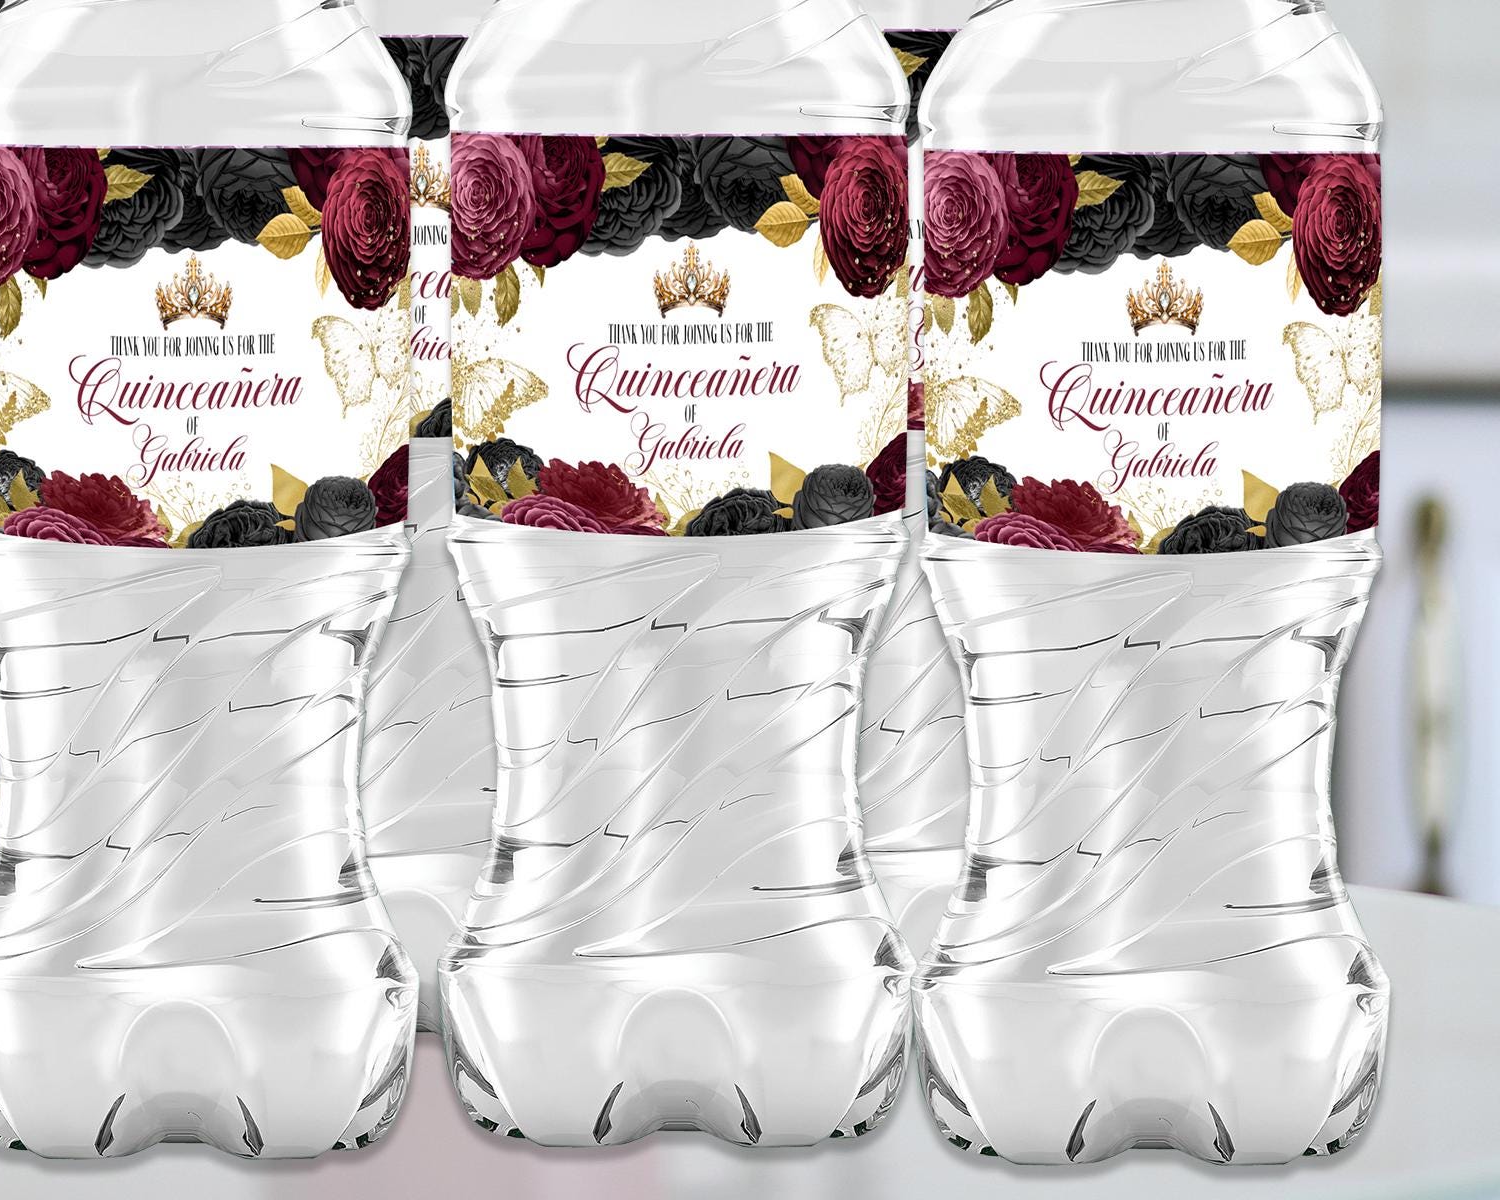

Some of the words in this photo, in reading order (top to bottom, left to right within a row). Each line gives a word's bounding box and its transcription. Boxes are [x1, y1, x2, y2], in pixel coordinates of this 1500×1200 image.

[413, 225, 447, 245] JOINING
[415, 305, 426, 324] OF
[609, 324, 637, 344] THANK
[641, 324, 658, 344] YOU
[662, 325, 679, 345] FOR
[683, 324, 717, 344] JOINING
[721, 324, 732, 344] US
[736, 323, 753, 343] FOR
[757, 322, 773, 342] THE
[111, 336, 139, 356] THANK
[143, 336, 159, 357] YOU
[164, 337, 181, 357] FOR
[185, 336, 219, 356] JOINING
[223, 336, 234, 356] US
[238, 335, 255, 355] FOR
[259, 334, 275, 354] THE
[1082, 342, 1110, 362] THANK
[1114, 342, 1130, 362] YOU
[1135, 343, 1152, 363] FOR
[1156, 342, 1190, 362] JOINING
[1194, 342, 1205, 362] US
[1209, 341, 1225, 361] FOR
[1230, 340, 1246, 360] THE
[566, 343, 801, 413] Quinceañera
[68, 355, 302, 425] Quinceañera
[1040, 360, 1273, 431] Quinceañera
[685, 404, 696, 423] OF
[187, 416, 198, 435] OF
[1158, 422, 1169, 441] OF
[126, 424, 247, 488] Gabriela
[623, 412, 746, 477] Gabriela
[1097, 430, 1219, 494] Gabriela
